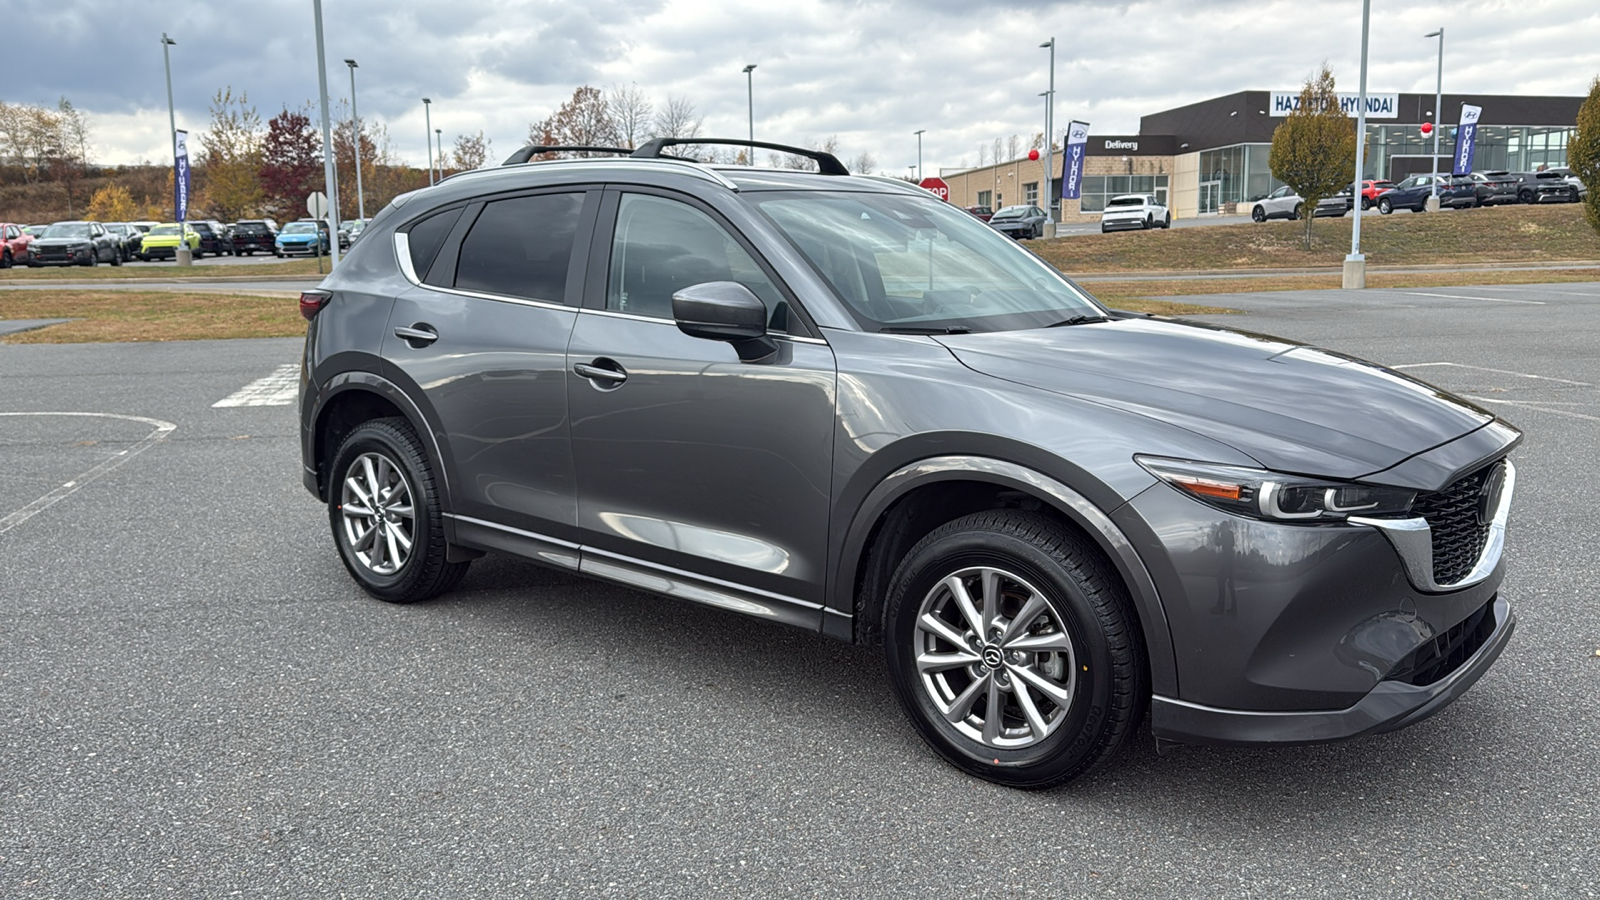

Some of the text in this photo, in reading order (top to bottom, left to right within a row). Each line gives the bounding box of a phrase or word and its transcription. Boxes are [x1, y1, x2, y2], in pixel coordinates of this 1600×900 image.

[1276, 95, 1337, 112] HAZTO
[1104, 140, 1138, 151] Delivery
[1460, 126, 1473, 173] HYUNDAI
[1068, 146, 1081, 197] HYUNDAI
[178, 158, 187, 219] HYUNDAI
[925, 187, 947, 198] OP
